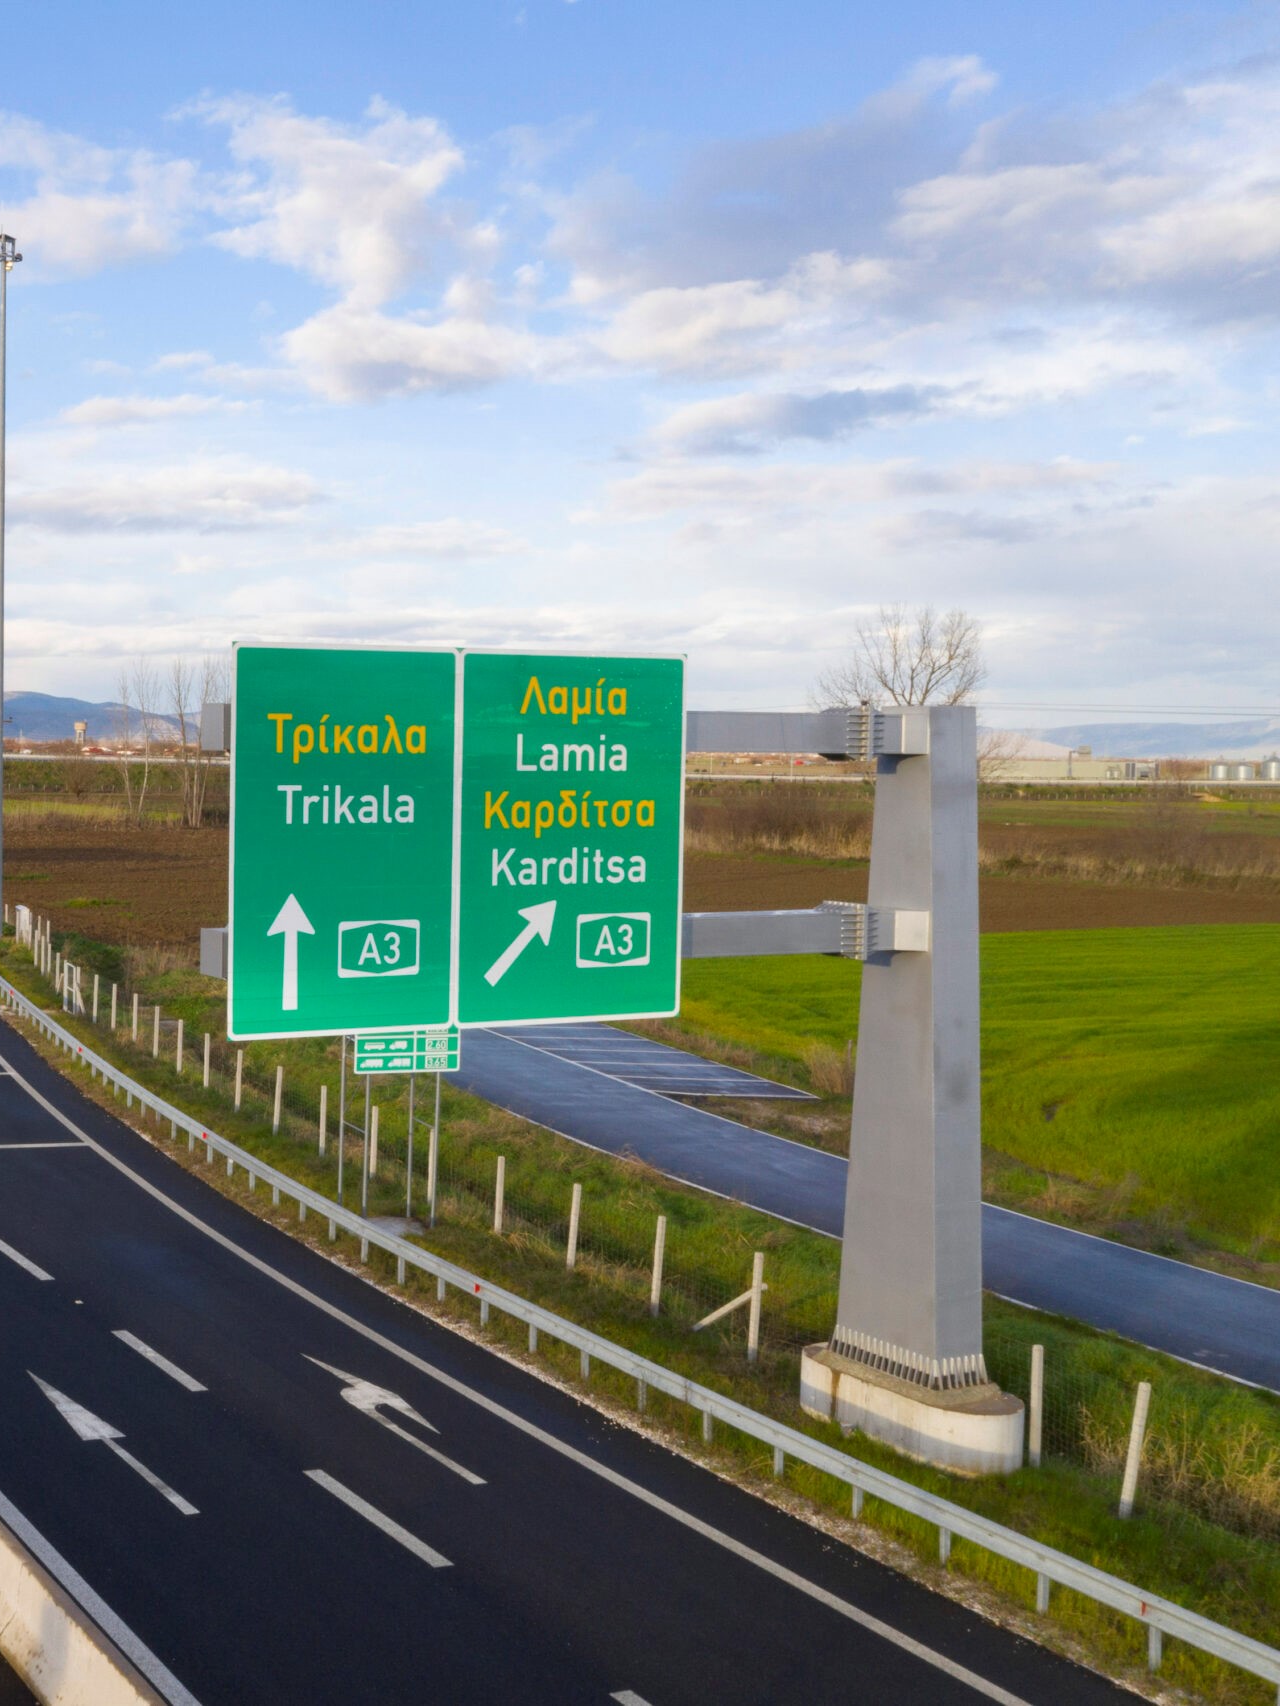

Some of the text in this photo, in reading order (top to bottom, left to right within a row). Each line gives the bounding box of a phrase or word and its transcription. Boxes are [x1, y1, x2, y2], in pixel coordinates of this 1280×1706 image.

[520, 676, 627, 725] Λαμία
[267, 713, 427, 764] Τρίκαλα
[516, 733, 628, 772] Lamia
[277, 784, 415, 825] Trikala
[484, 789, 655, 839] Καρδίτσα
[491, 847, 646, 886] Karditsa
[357, 931, 401, 966] A3
[594, 923, 634, 956] A3
